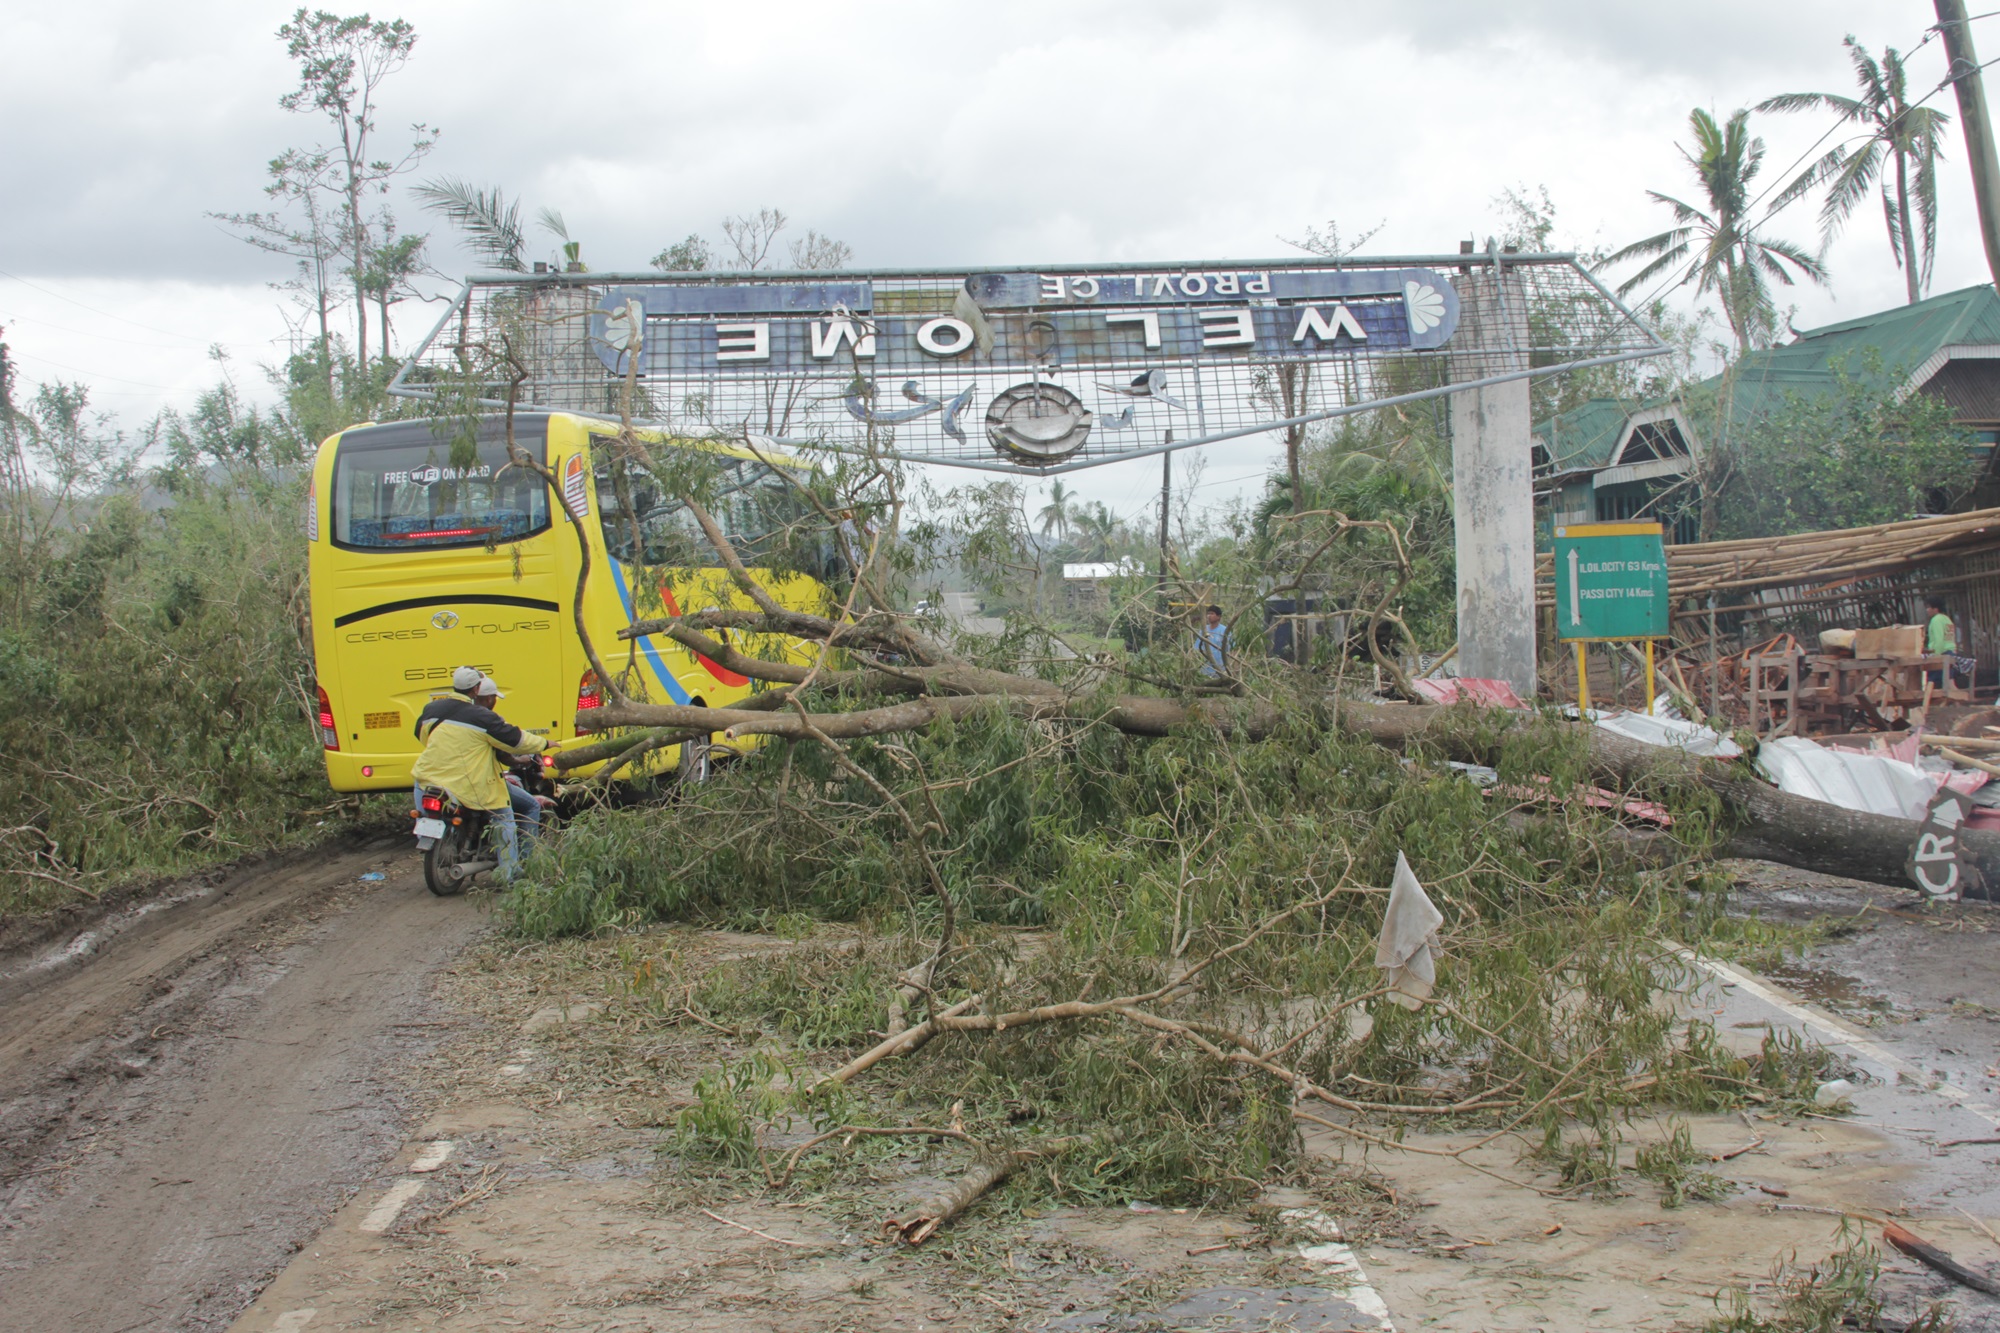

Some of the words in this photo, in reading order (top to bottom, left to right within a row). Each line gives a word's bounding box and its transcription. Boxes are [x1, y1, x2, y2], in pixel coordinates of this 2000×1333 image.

[384, 471, 407, 484] FREE
[442, 467, 456, 480] ON
[1627, 561, 1640, 571] 63
[1580, 588, 1604, 599] PASSI
[1605, 588, 1624, 598] CITY
[1626, 588, 1635, 598] 14
[345, 629, 428, 643] CERES
[464, 620, 550, 634] TOURS
